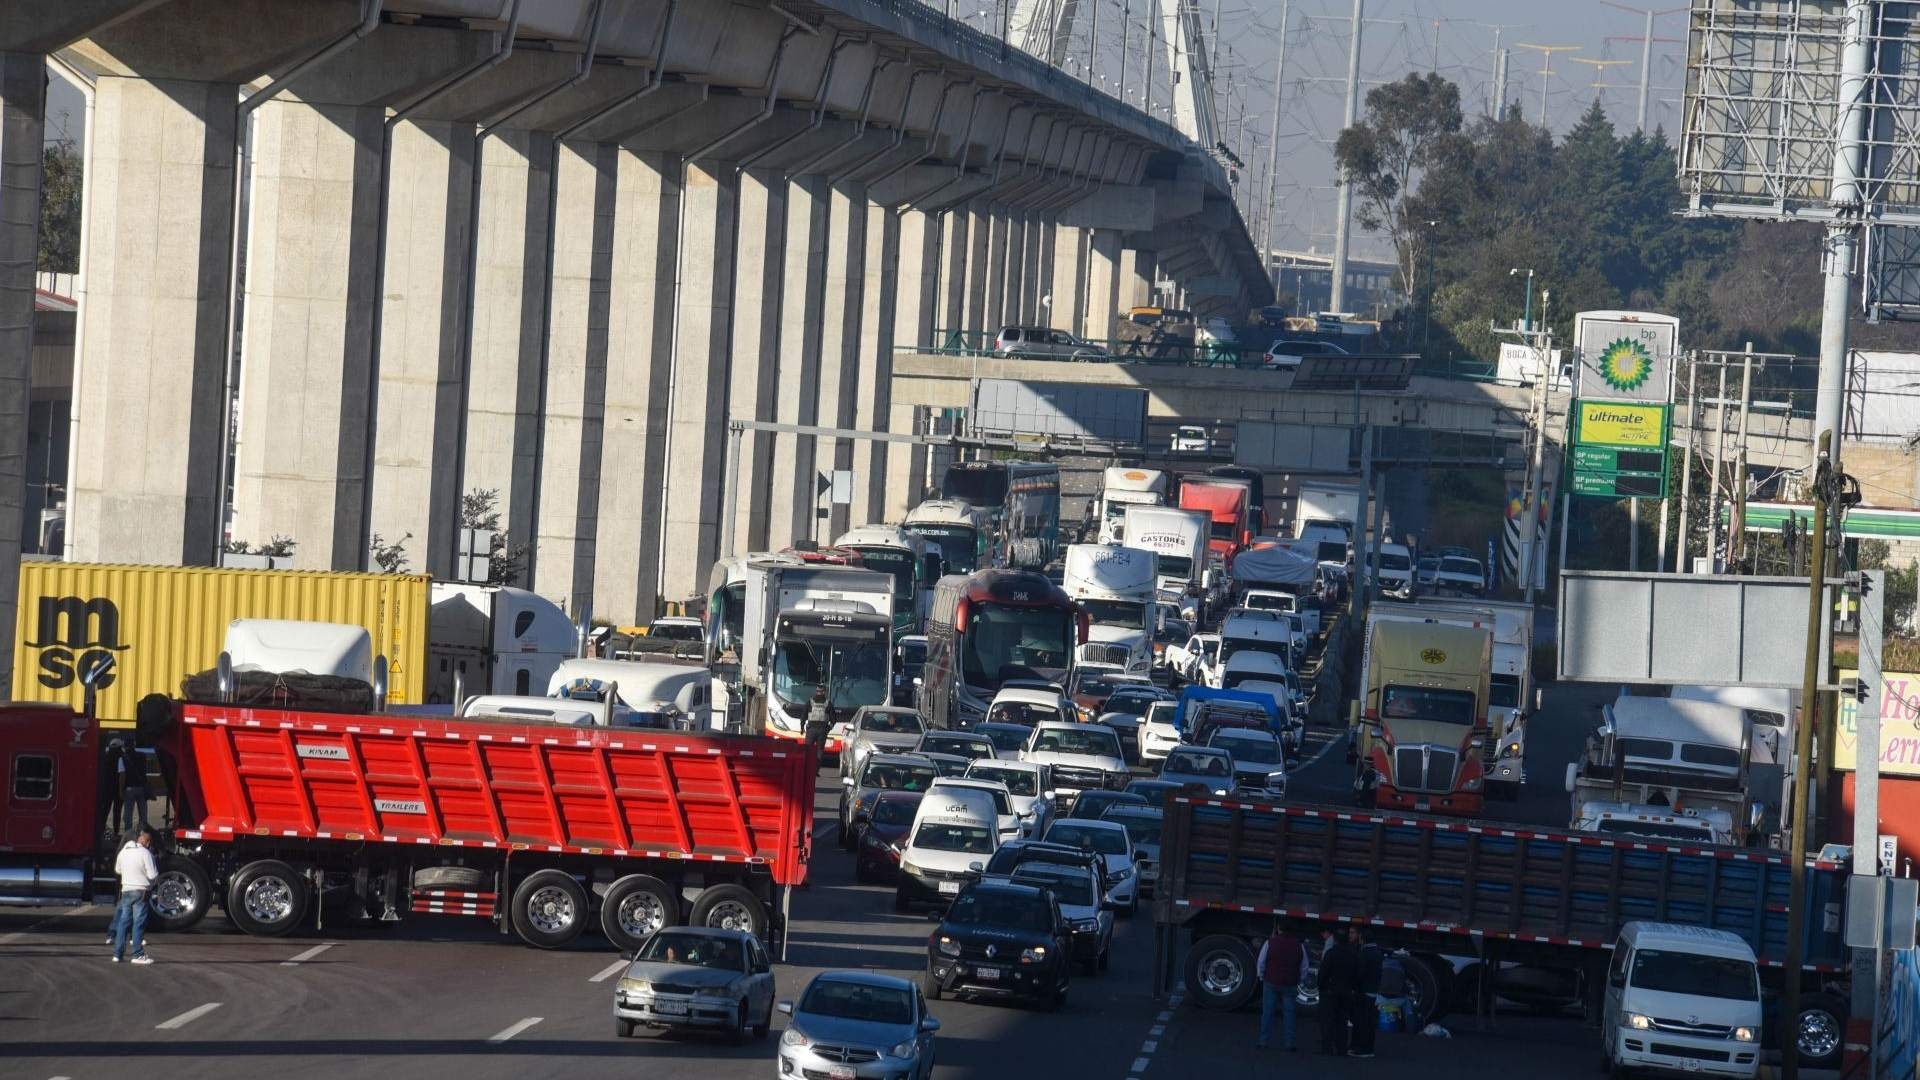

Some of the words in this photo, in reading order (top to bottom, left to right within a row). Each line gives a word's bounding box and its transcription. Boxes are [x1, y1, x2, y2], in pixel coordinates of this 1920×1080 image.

[1641, 328, 1657, 341] bp
[1140, 535, 1186, 546] CASTORES
[308, 748, 338, 756] KINAM
[381, 802, 420, 811] TRAILERS
